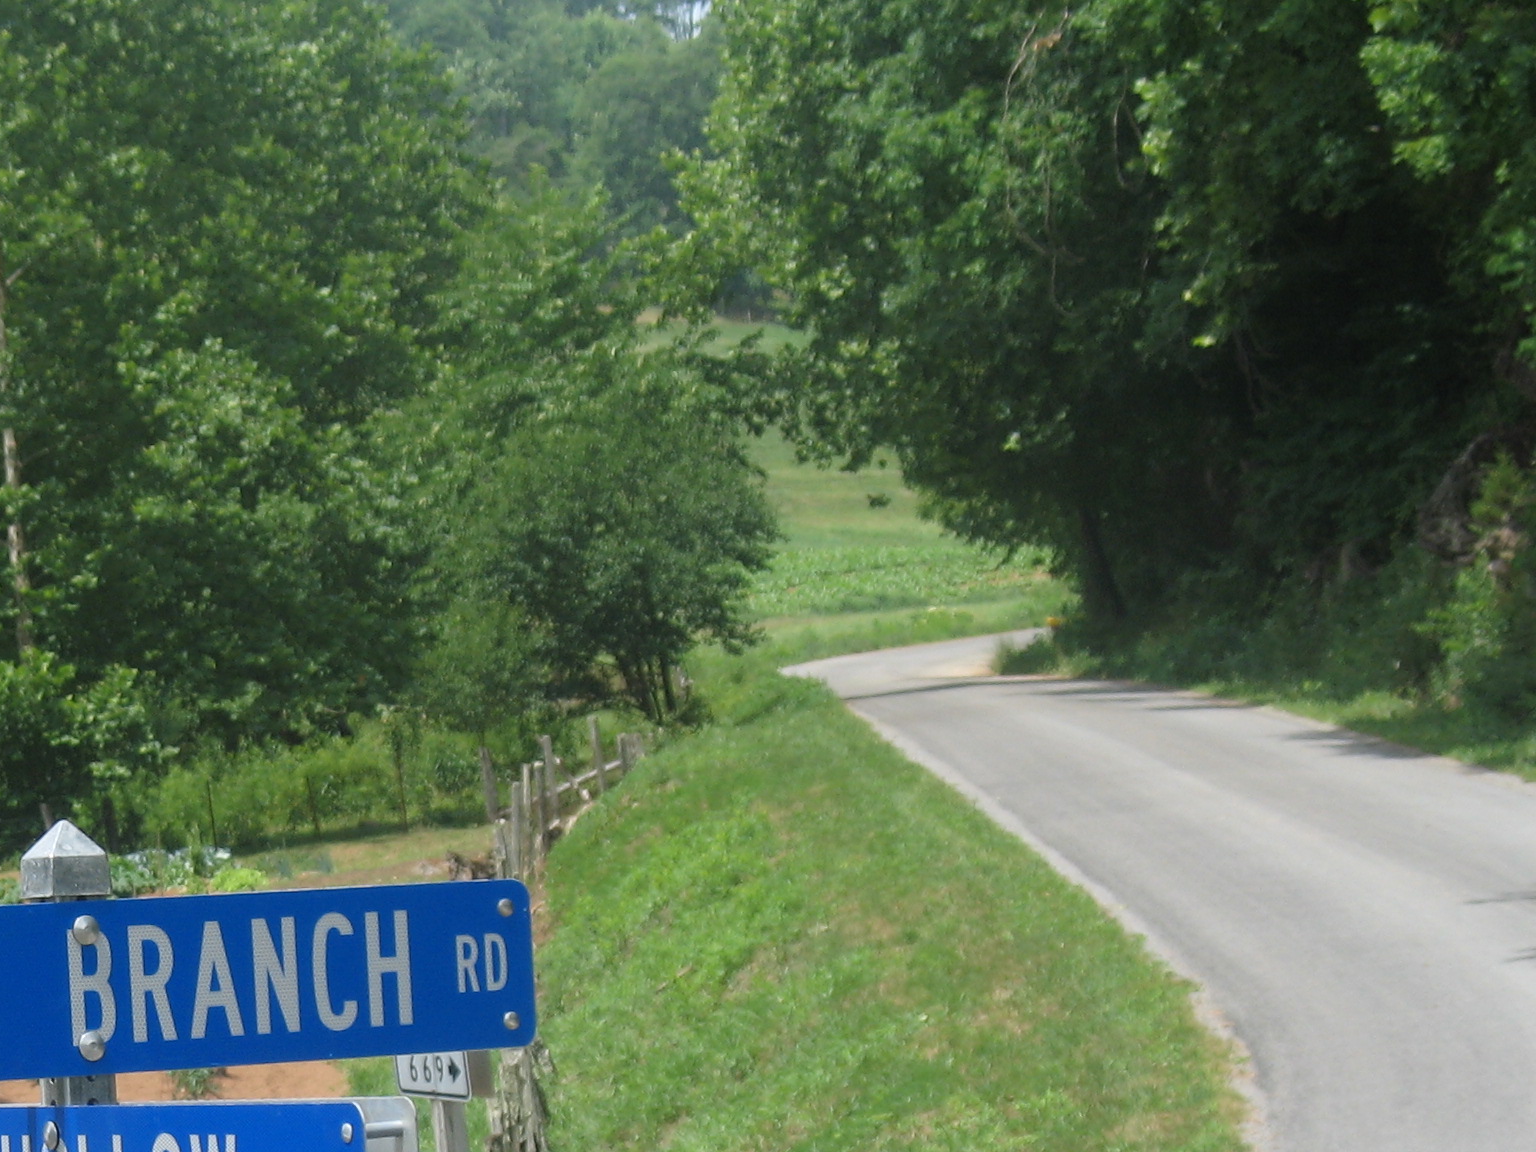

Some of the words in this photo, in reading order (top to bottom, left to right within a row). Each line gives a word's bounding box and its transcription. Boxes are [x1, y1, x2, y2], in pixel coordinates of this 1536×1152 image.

[66, 909, 415, 1052] BRANCH
[456, 933, 508, 993] RD
[410, 1055, 444, 1083] 669
